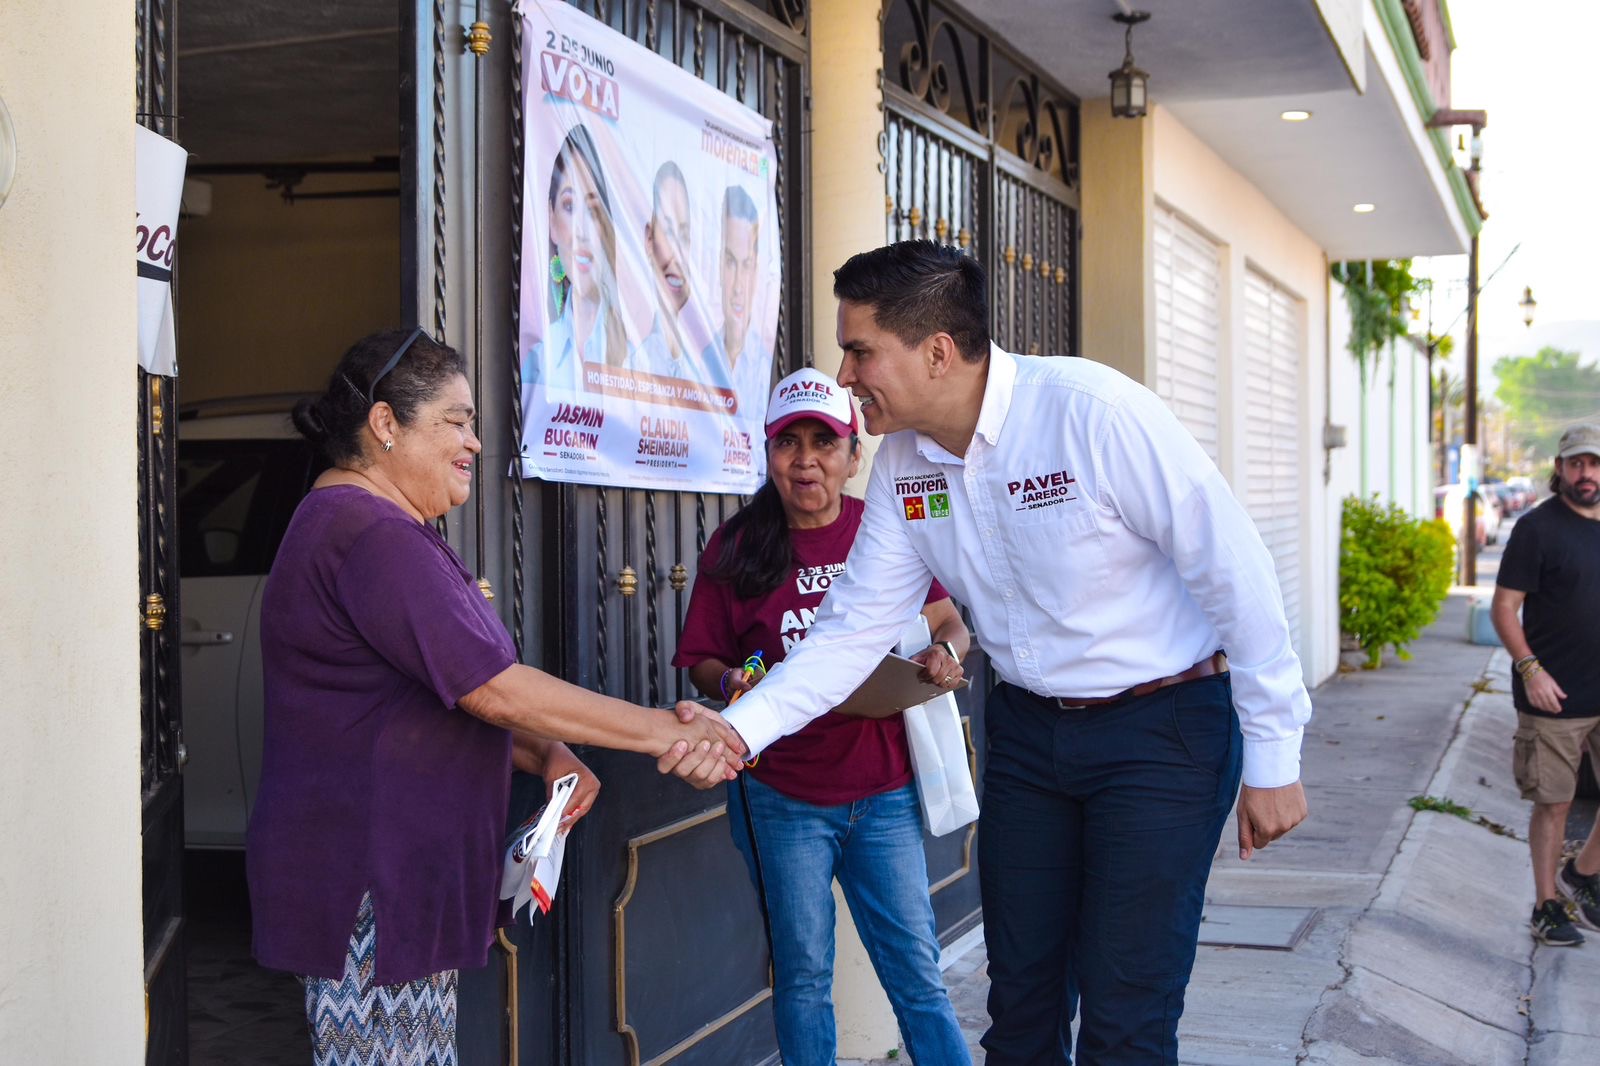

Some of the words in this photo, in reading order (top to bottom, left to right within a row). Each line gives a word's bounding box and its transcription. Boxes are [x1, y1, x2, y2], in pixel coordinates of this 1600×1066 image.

[546, 30, 556, 50] 2
[581, 45, 615, 77] JUNIO
[542, 53, 618, 118] VOTA
[701, 127, 749, 172] morena
[779, 381, 833, 398] PAVEL
[784, 390, 828, 402] JARERO
[551, 403, 605, 428] JASMIN
[640, 416, 688, 441] CLAUDIA
[544, 428, 599, 450] BUGARIN
[637, 438, 689, 458] SHEINBAUM
[560, 451, 585, 461] SENADORA
[646, 459, 677, 468] PRESIDENTA
[1007, 470, 1075, 495] PAVEL
[1020, 486, 1068, 504] JARERO
[1028, 498, 1064, 510] SENADOR
[905, 504, 923, 519] PT
[798, 568, 806, 577] 2
[808, 565, 823, 576] DE
